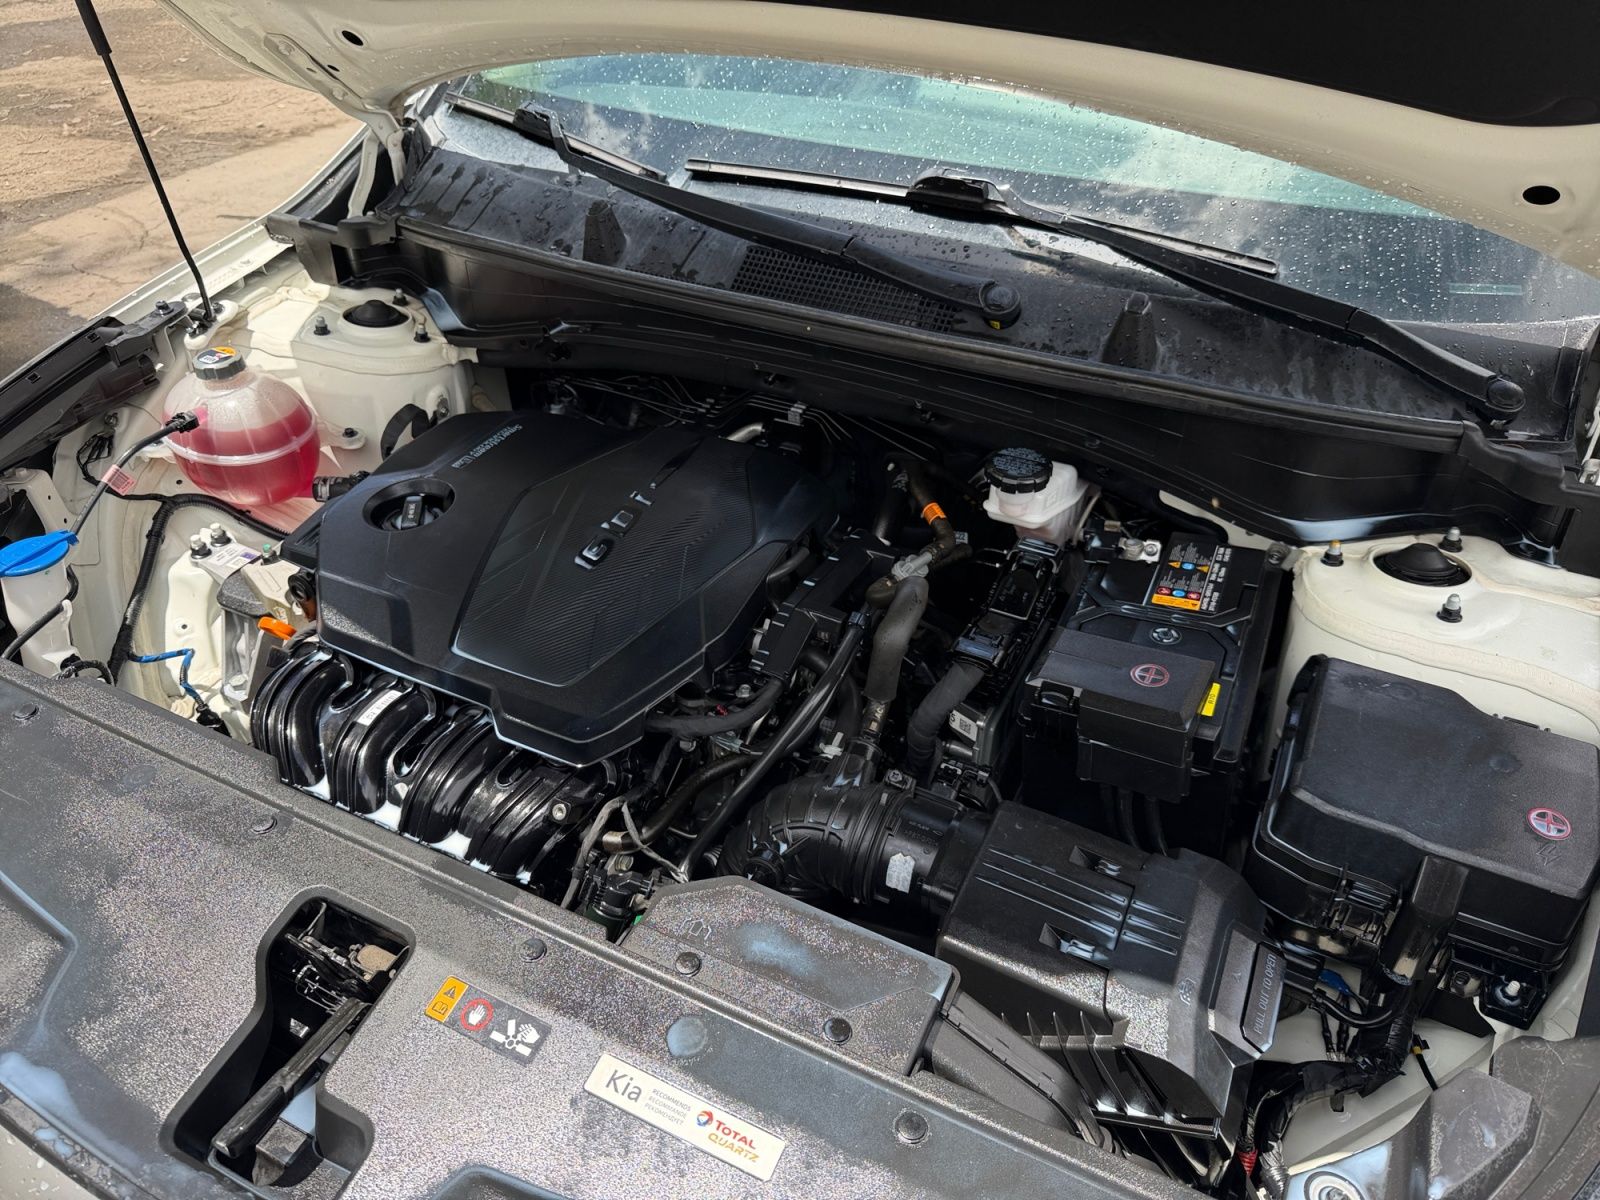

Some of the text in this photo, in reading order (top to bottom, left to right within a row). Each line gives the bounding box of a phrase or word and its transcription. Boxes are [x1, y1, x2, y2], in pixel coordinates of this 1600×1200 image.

[472, 423, 523, 458] Smartstream
[1254, 953, 1277, 1034] PULL OUT TO OPEN
[605, 1069, 643, 1103] Kia
[652, 1088, 691, 1112] RECOMMENDS
[708, 1132, 760, 1163] QUARTZ
[715, 1119, 757, 1150] TOTAL
